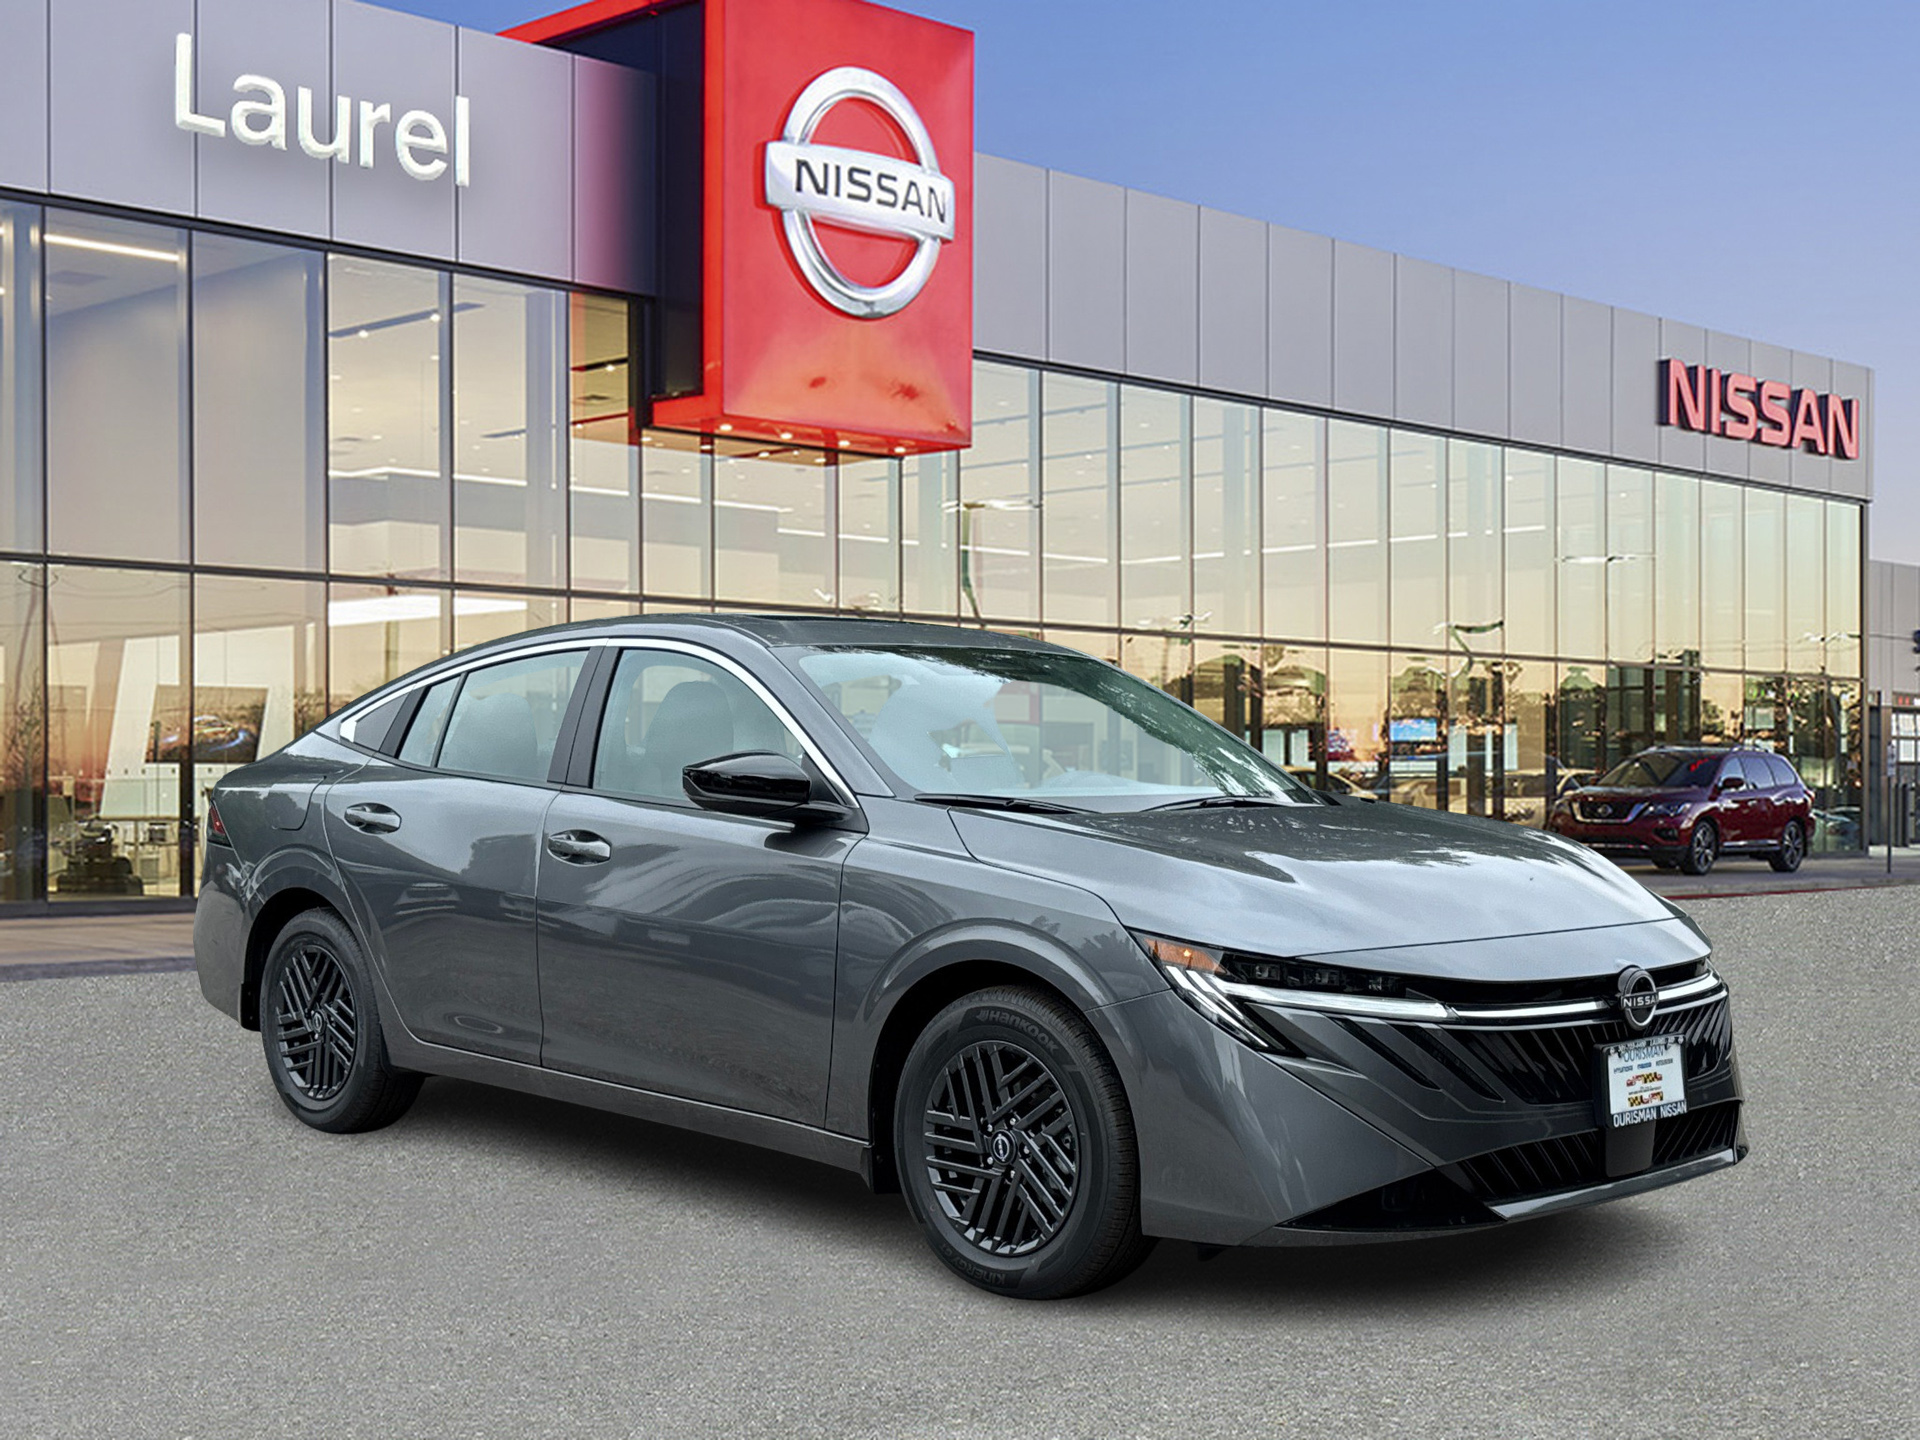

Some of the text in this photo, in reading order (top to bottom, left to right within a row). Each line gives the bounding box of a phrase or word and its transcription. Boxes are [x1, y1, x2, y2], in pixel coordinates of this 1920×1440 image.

[175, 33, 470, 187] Laurel
[795, 158, 947, 225] NISSAN
[1661, 358, 1860, 459] NISSAN
[1613, 1100, 1687, 1128] OURISMAN NISSAN
